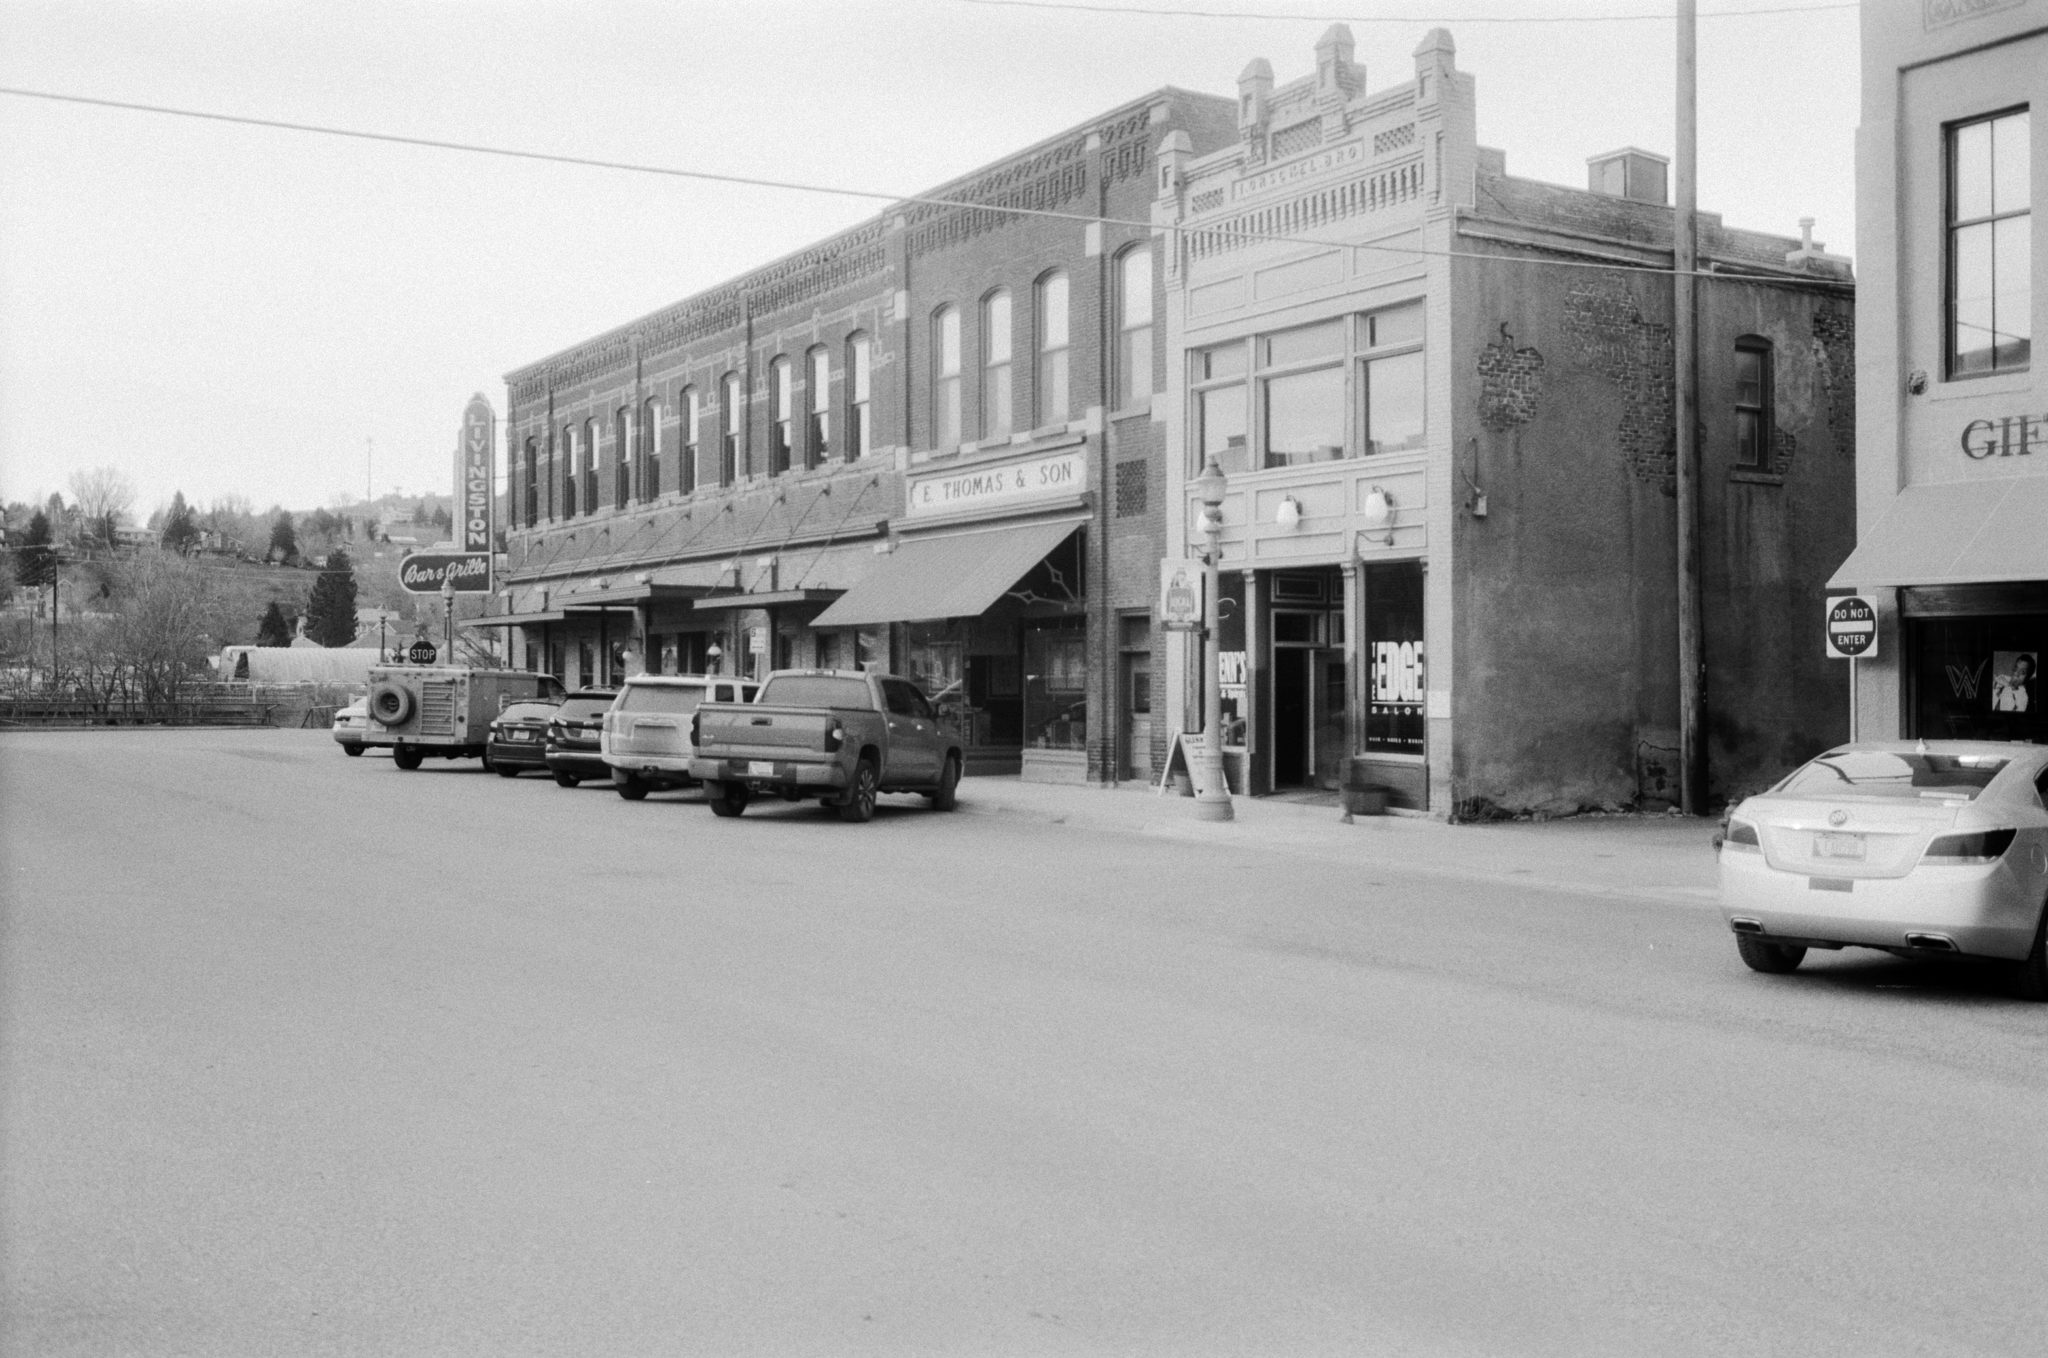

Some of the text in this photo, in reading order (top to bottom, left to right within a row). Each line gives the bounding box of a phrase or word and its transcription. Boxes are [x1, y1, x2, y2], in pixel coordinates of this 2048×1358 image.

[468, 413, 487, 546] LIVINGSTON
[943, 473, 1003, 500] THOMAS
[1016, 469, 1025, 488] &
[1040, 461, 1072, 485] SON
[404, 564, 434, 584] Bar
[446, 557, 487, 580] Grille
[1834, 608, 1869, 620] DO NOT
[1838, 634, 1866, 645] ENTER
[411, 649, 436, 660] STOP
[1377, 640, 1423, 701] EDGE
[1371, 705, 1423, 716] SALON
